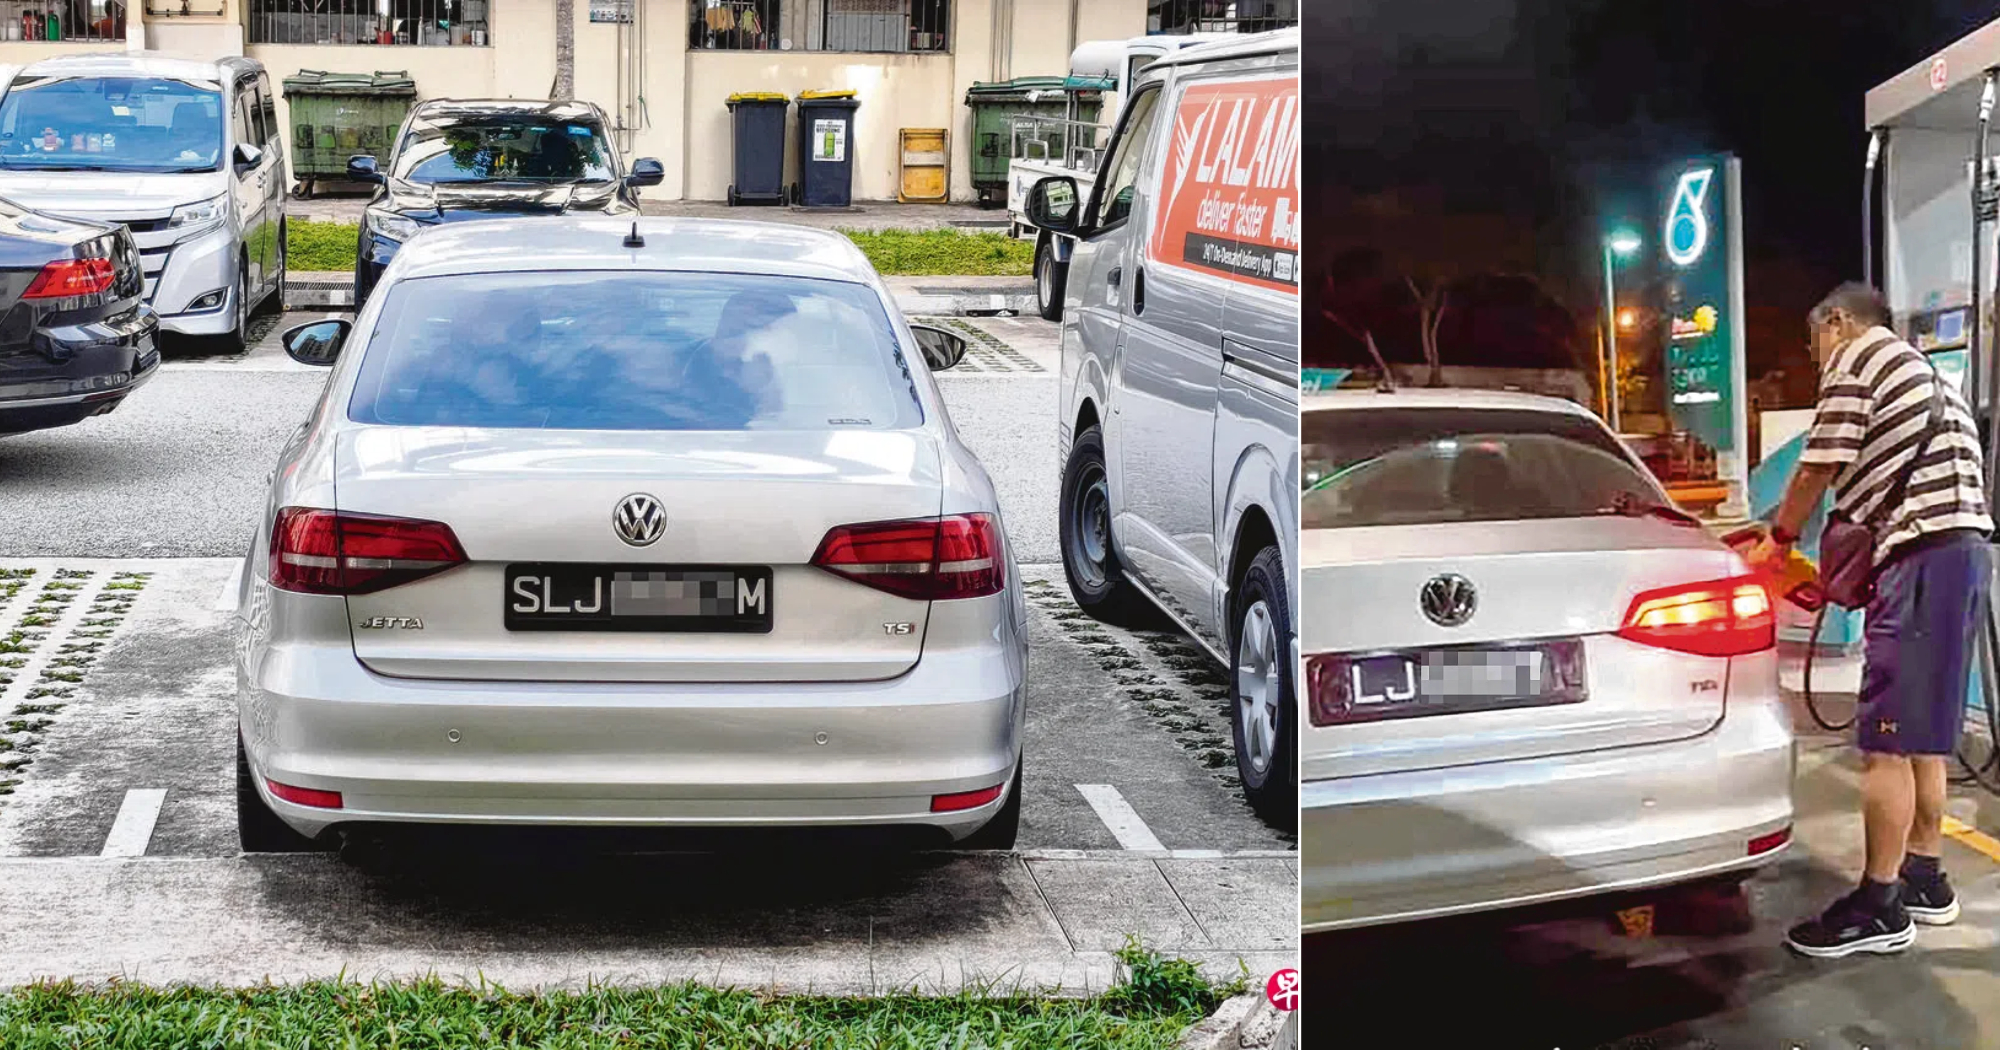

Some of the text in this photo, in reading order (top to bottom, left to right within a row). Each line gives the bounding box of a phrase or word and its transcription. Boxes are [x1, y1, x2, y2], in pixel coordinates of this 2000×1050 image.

[1196, 95, 1298, 190] LALAM
[1196, 189, 1267, 238] deliver faster
[1241, 249, 1262, 276] Delivery
[1261, 254, 1272, 277] App
[360, 617, 424, 629] JETTA
